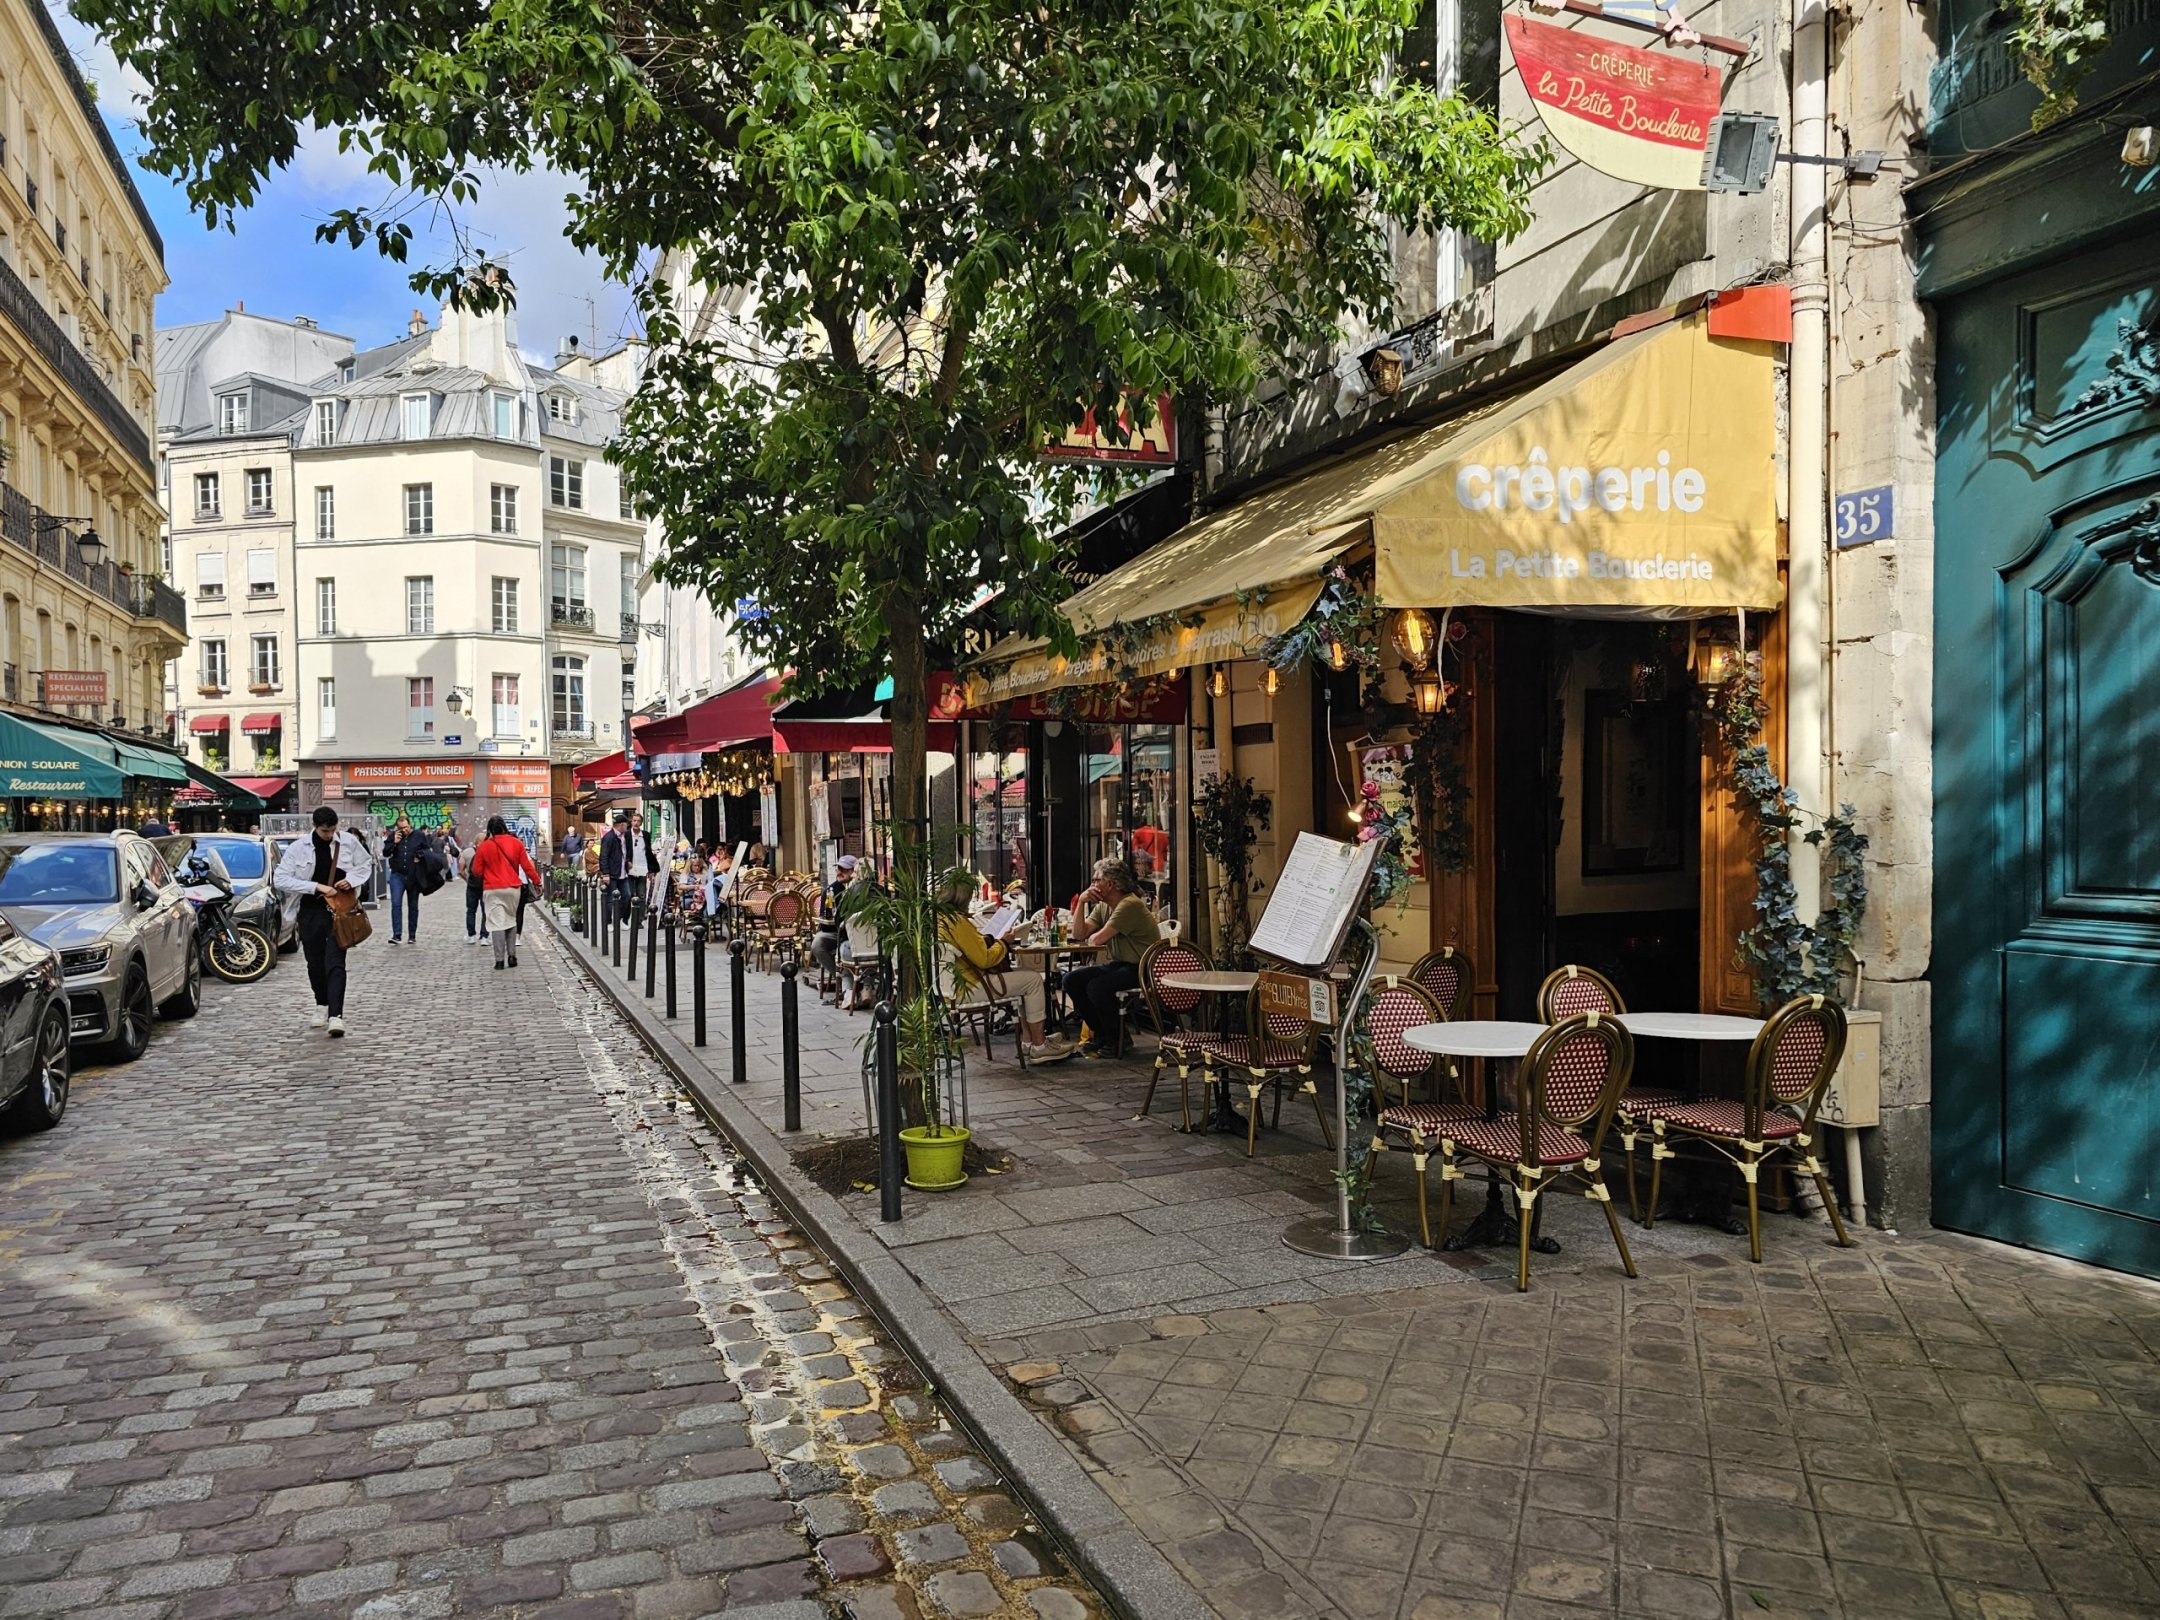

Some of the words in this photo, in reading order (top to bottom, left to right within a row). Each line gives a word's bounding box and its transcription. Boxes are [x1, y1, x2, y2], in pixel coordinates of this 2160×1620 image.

[1590, 51, 1656, 86] CRÊPERIE
[1537, 71, 1559, 96] la
[1564, 77, 1615, 119] Petite
[1617, 95, 1703, 143] Bouclerie
[1455, 445, 1706, 525] crêperie
[1837, 494, 1881, 540] 35
[1450, 549, 1485, 579] La
[1495, 550, 1580, 580] Petite
[1588, 551, 1713, 581] Bouclerie
[48, 673, 104, 681] RESTAURANT
[1009, 665, 1050, 688] Bouclerie
[31, 761, 80, 770] SQUARE
[354, 766, 402, 777] PATISSERIE
[405, 766, 422, 776] SUD
[426, 765, 465, 776] TUNISIEN
[9, 778, 86, 791] Restaurant
